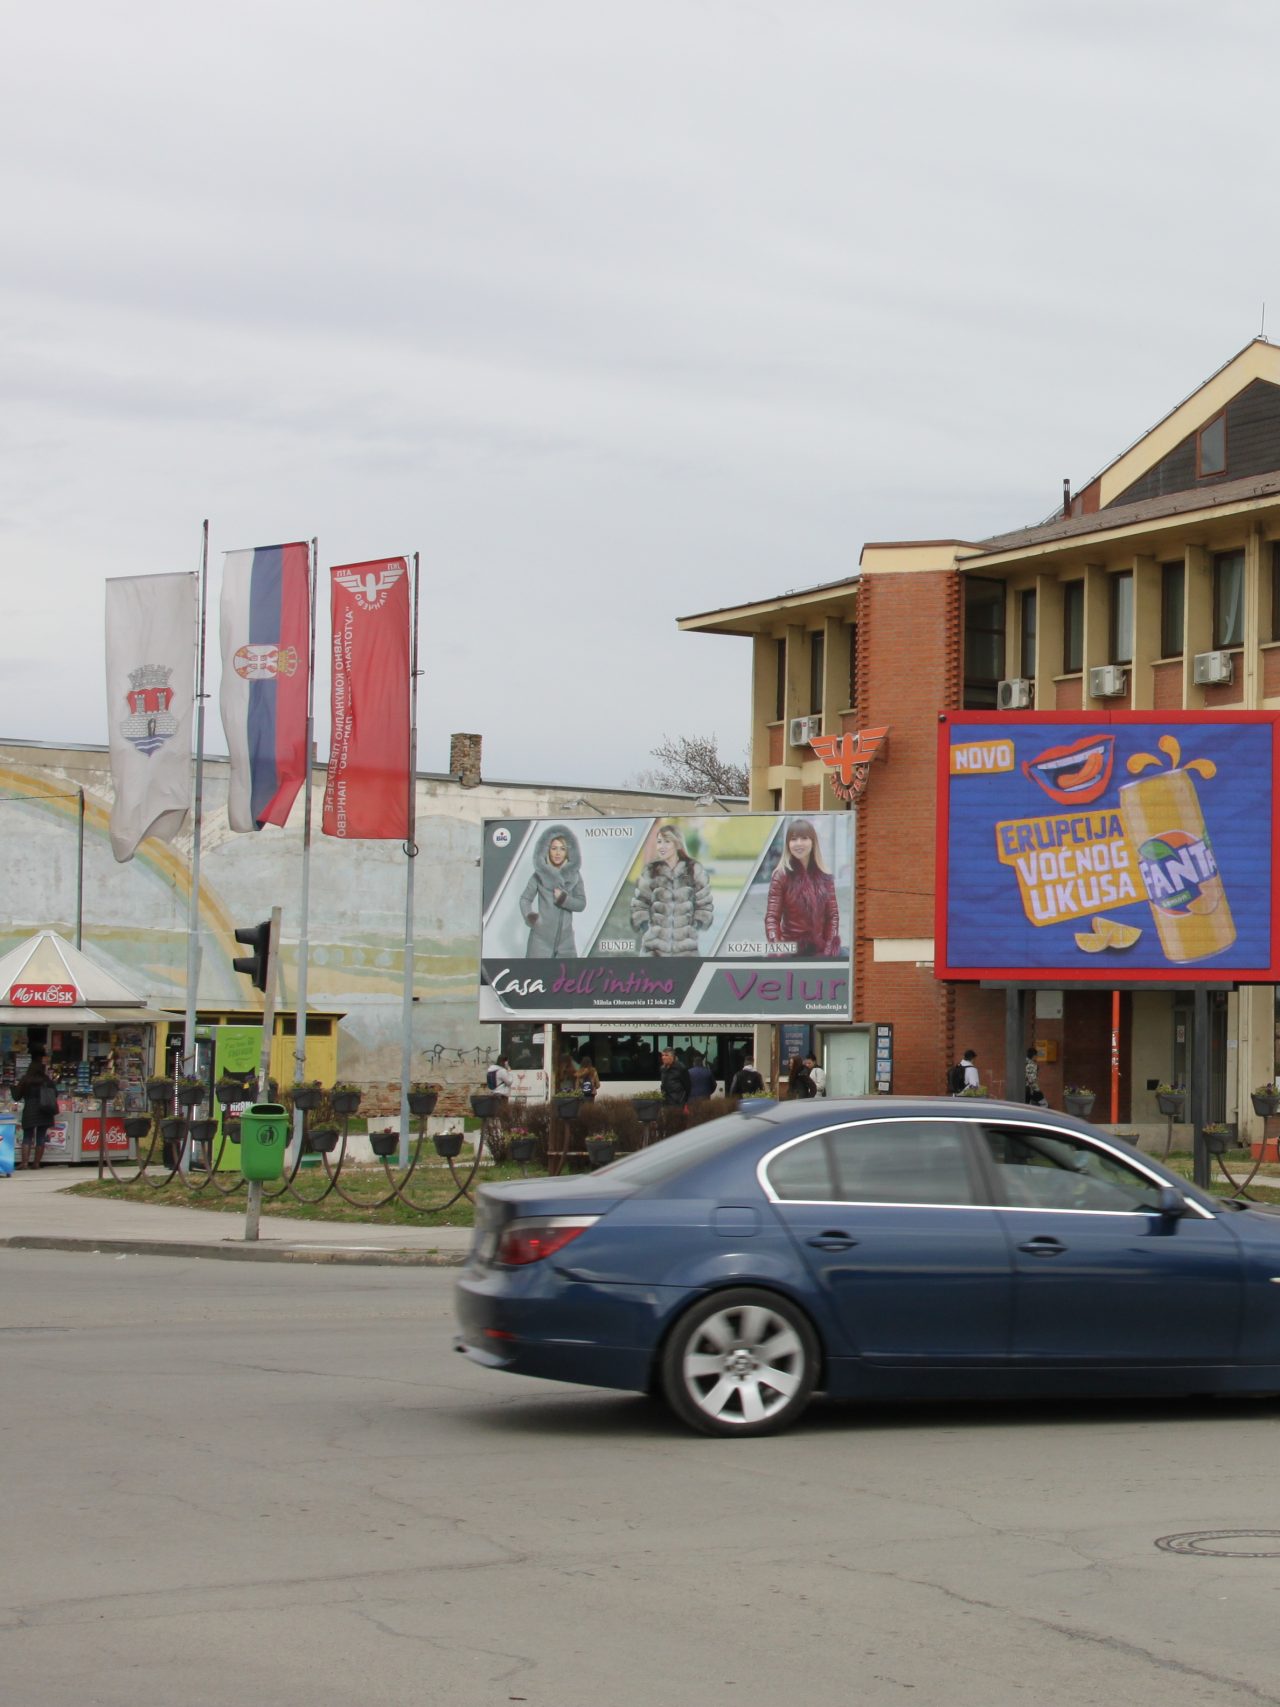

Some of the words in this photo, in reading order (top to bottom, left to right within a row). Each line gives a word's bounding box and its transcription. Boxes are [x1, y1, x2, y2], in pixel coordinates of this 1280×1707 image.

[955, 744, 1011, 770] NOVO
[585, 827, 633, 838] MONTONI
[1001, 814, 1124, 856] ERUPCIJA
[1016, 840, 1130, 887] VOĆNOG
[1139, 841, 1216, 900] FANTA
[1030, 872, 1137, 920] UKUSA
[601, 941, 635, 951] BUNDE
[728, 943, 762, 953] KOŽNE
[765, 943, 797, 953] JAKNE
[12, 987, 35, 1004] Moj
[492, 968, 547, 996] Casa
[723, 969, 848, 1001] Velur
[83, 1130, 100, 1146] Moj
